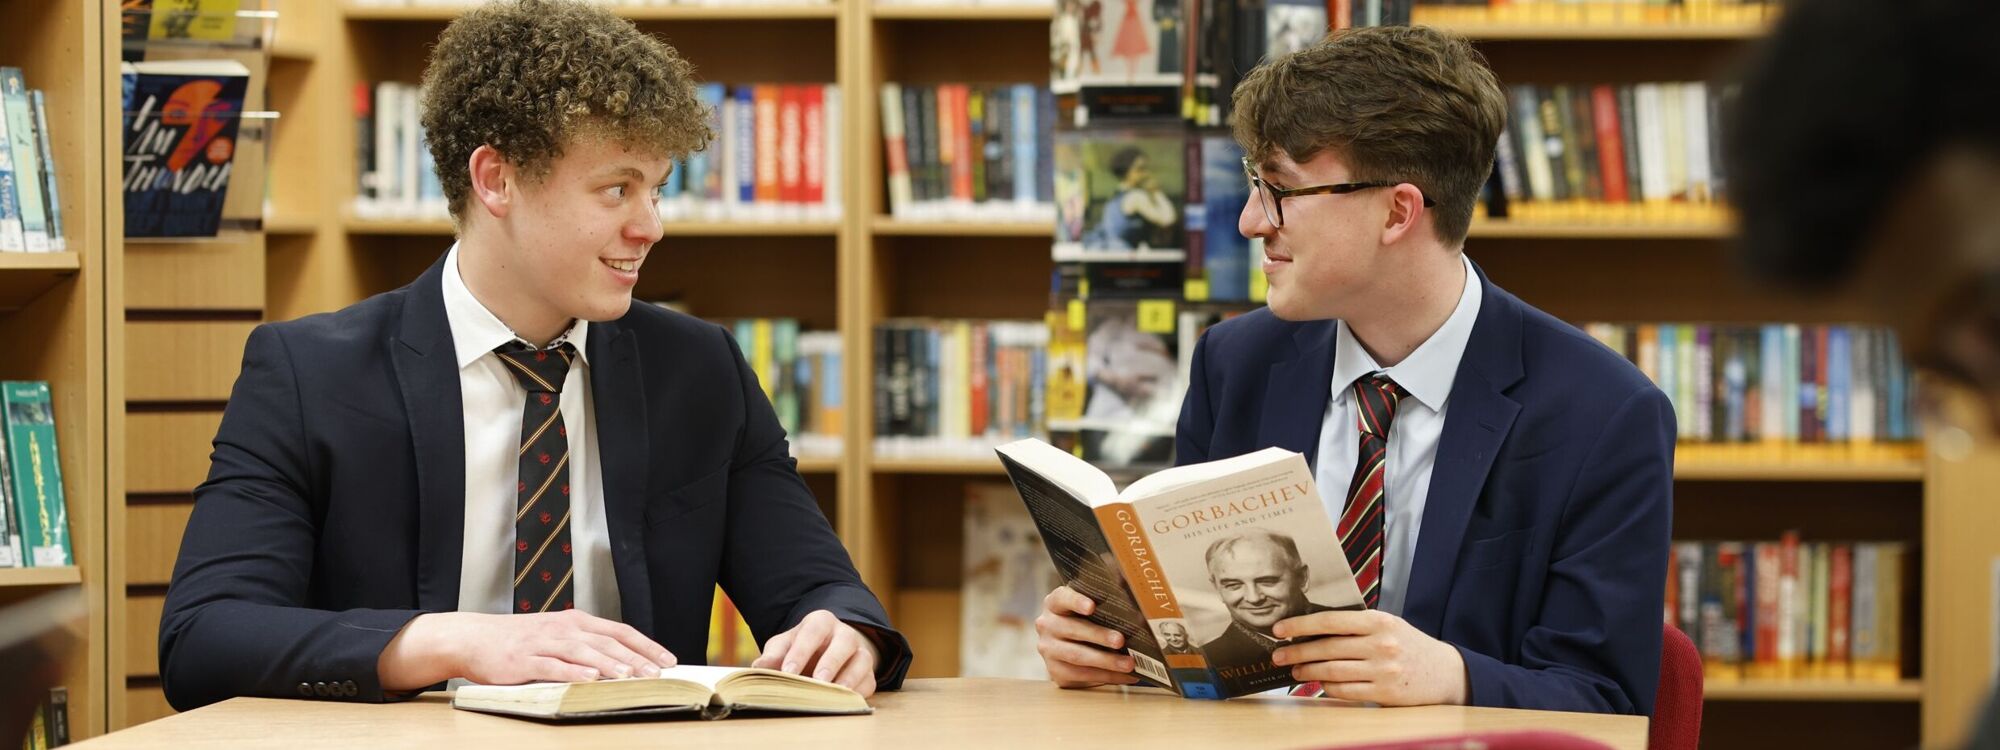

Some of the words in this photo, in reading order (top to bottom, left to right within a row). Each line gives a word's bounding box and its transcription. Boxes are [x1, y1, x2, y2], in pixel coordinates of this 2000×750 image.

[132, 95, 156, 131] I
[126, 119, 177, 155] AM
[1153, 480, 1311, 535] GORBACHEV
[1184, 530, 1201, 540] HIS
[1207, 523, 1230, 535] LIFE
[1234, 516, 1257, 527] AND
[1261, 507, 1295, 521] TIMES
[1116, 509, 1175, 613] GORBACHEV
